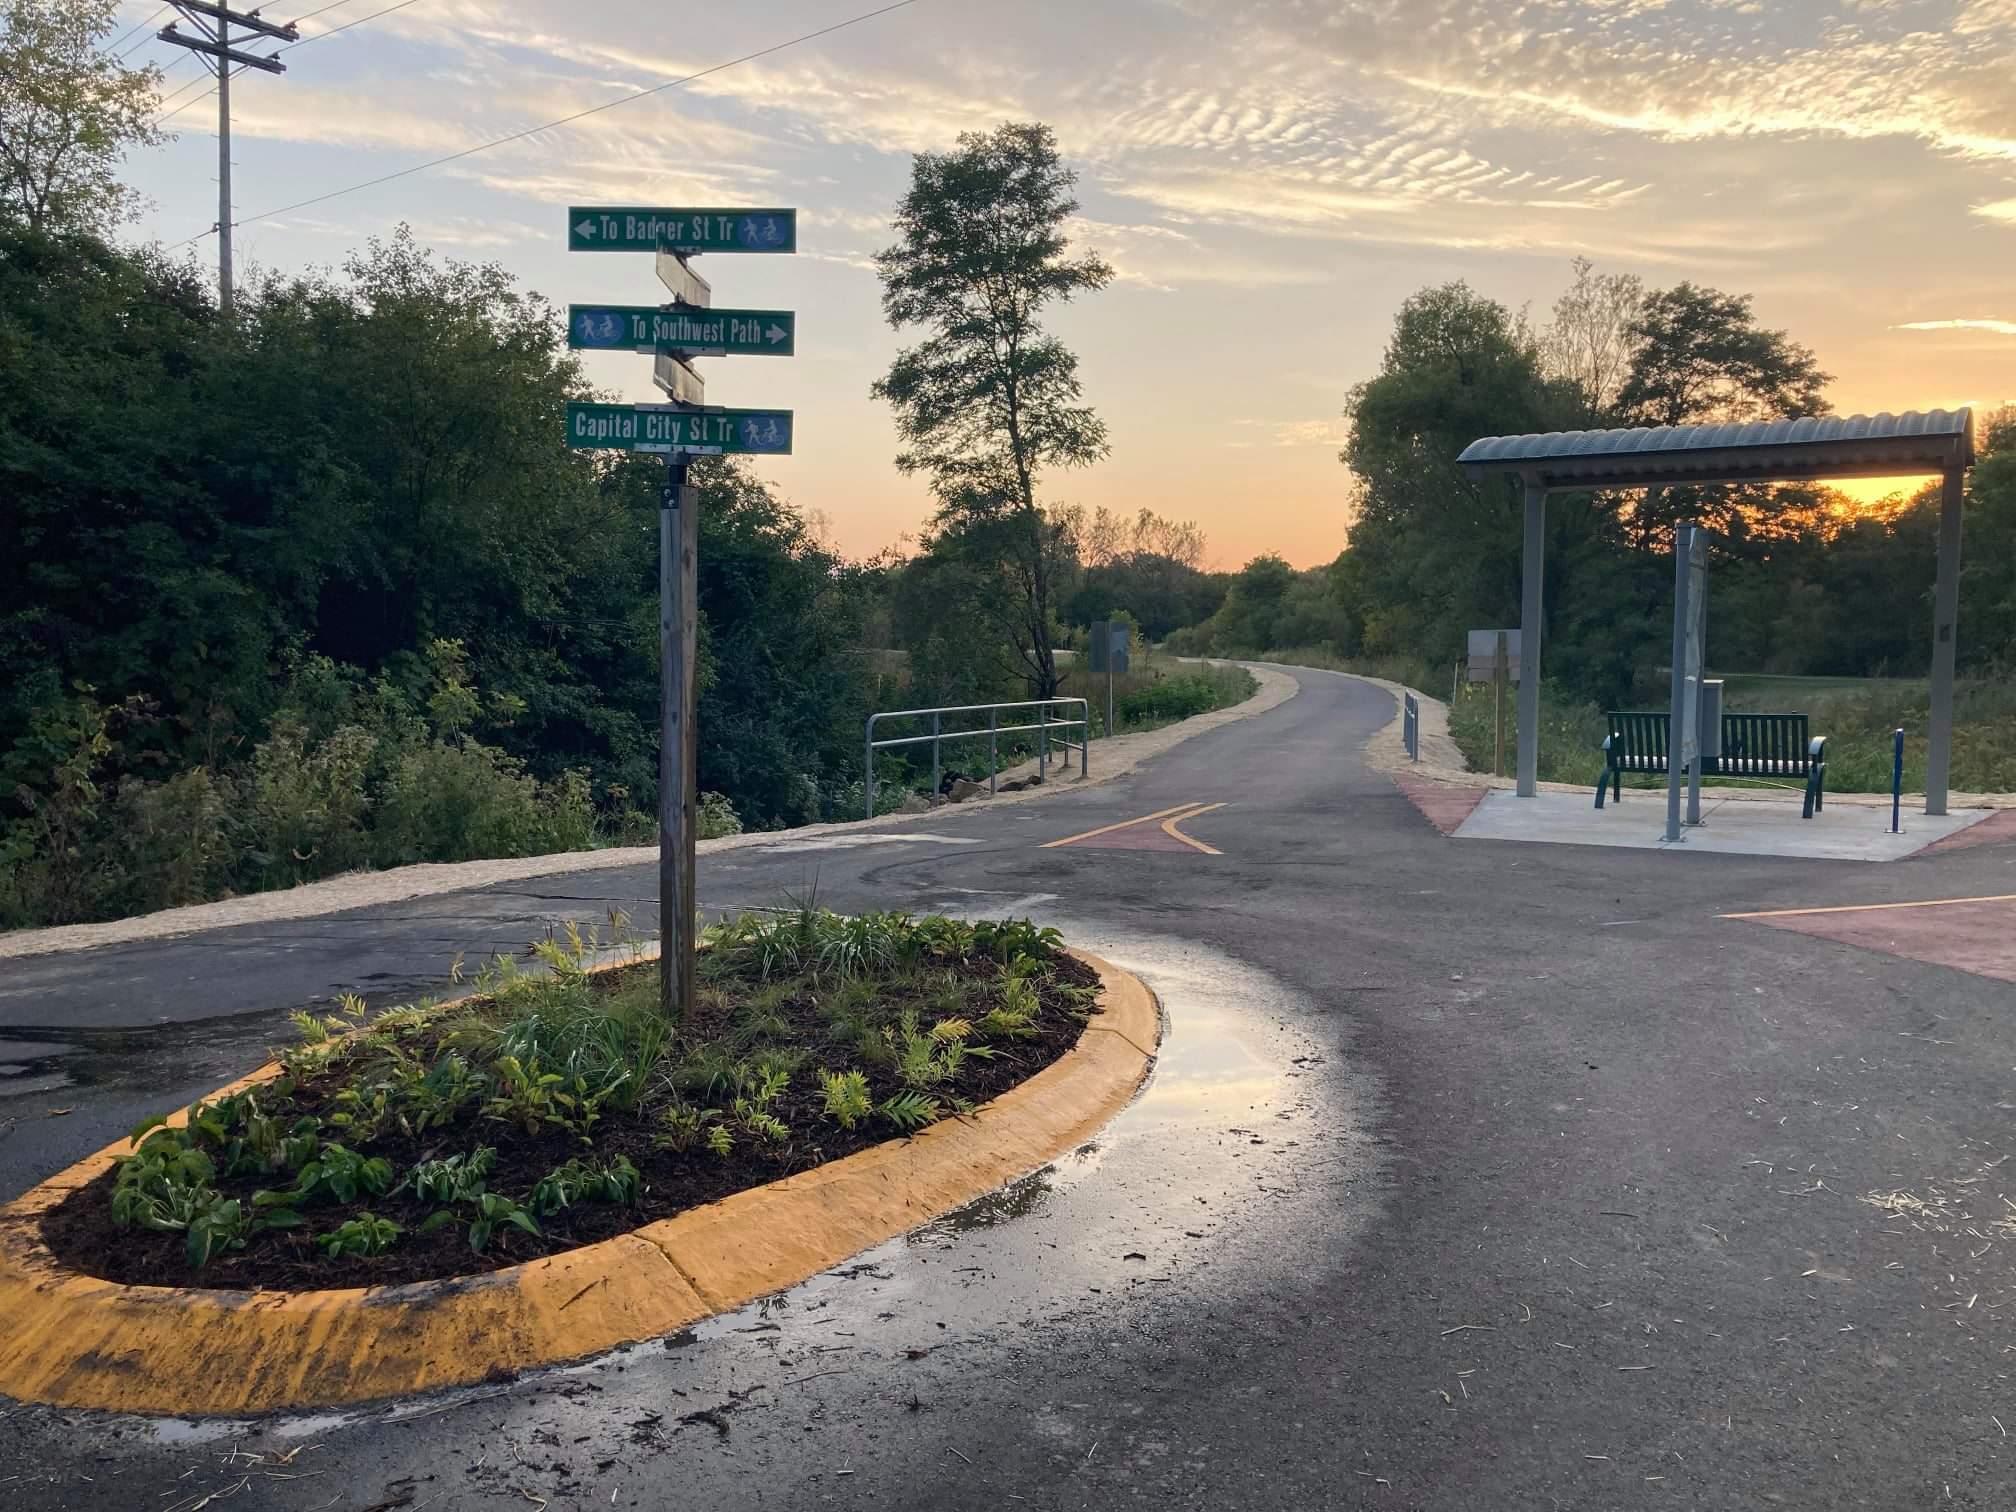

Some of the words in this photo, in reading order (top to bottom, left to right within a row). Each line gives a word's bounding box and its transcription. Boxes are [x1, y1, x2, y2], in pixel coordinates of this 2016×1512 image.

[599, 215, 618, 240] To
[692, 215, 710, 241] St
[717, 216, 734, 241] Tr
[631, 315, 646, 339] To
[652, 315, 725, 342] Southwest
[731, 319, 761, 344] Path
[575, 412, 638, 440] Capital
[646, 415, 681, 443] City
[690, 417, 708, 441] St
[717, 418, 734, 442] Tr
